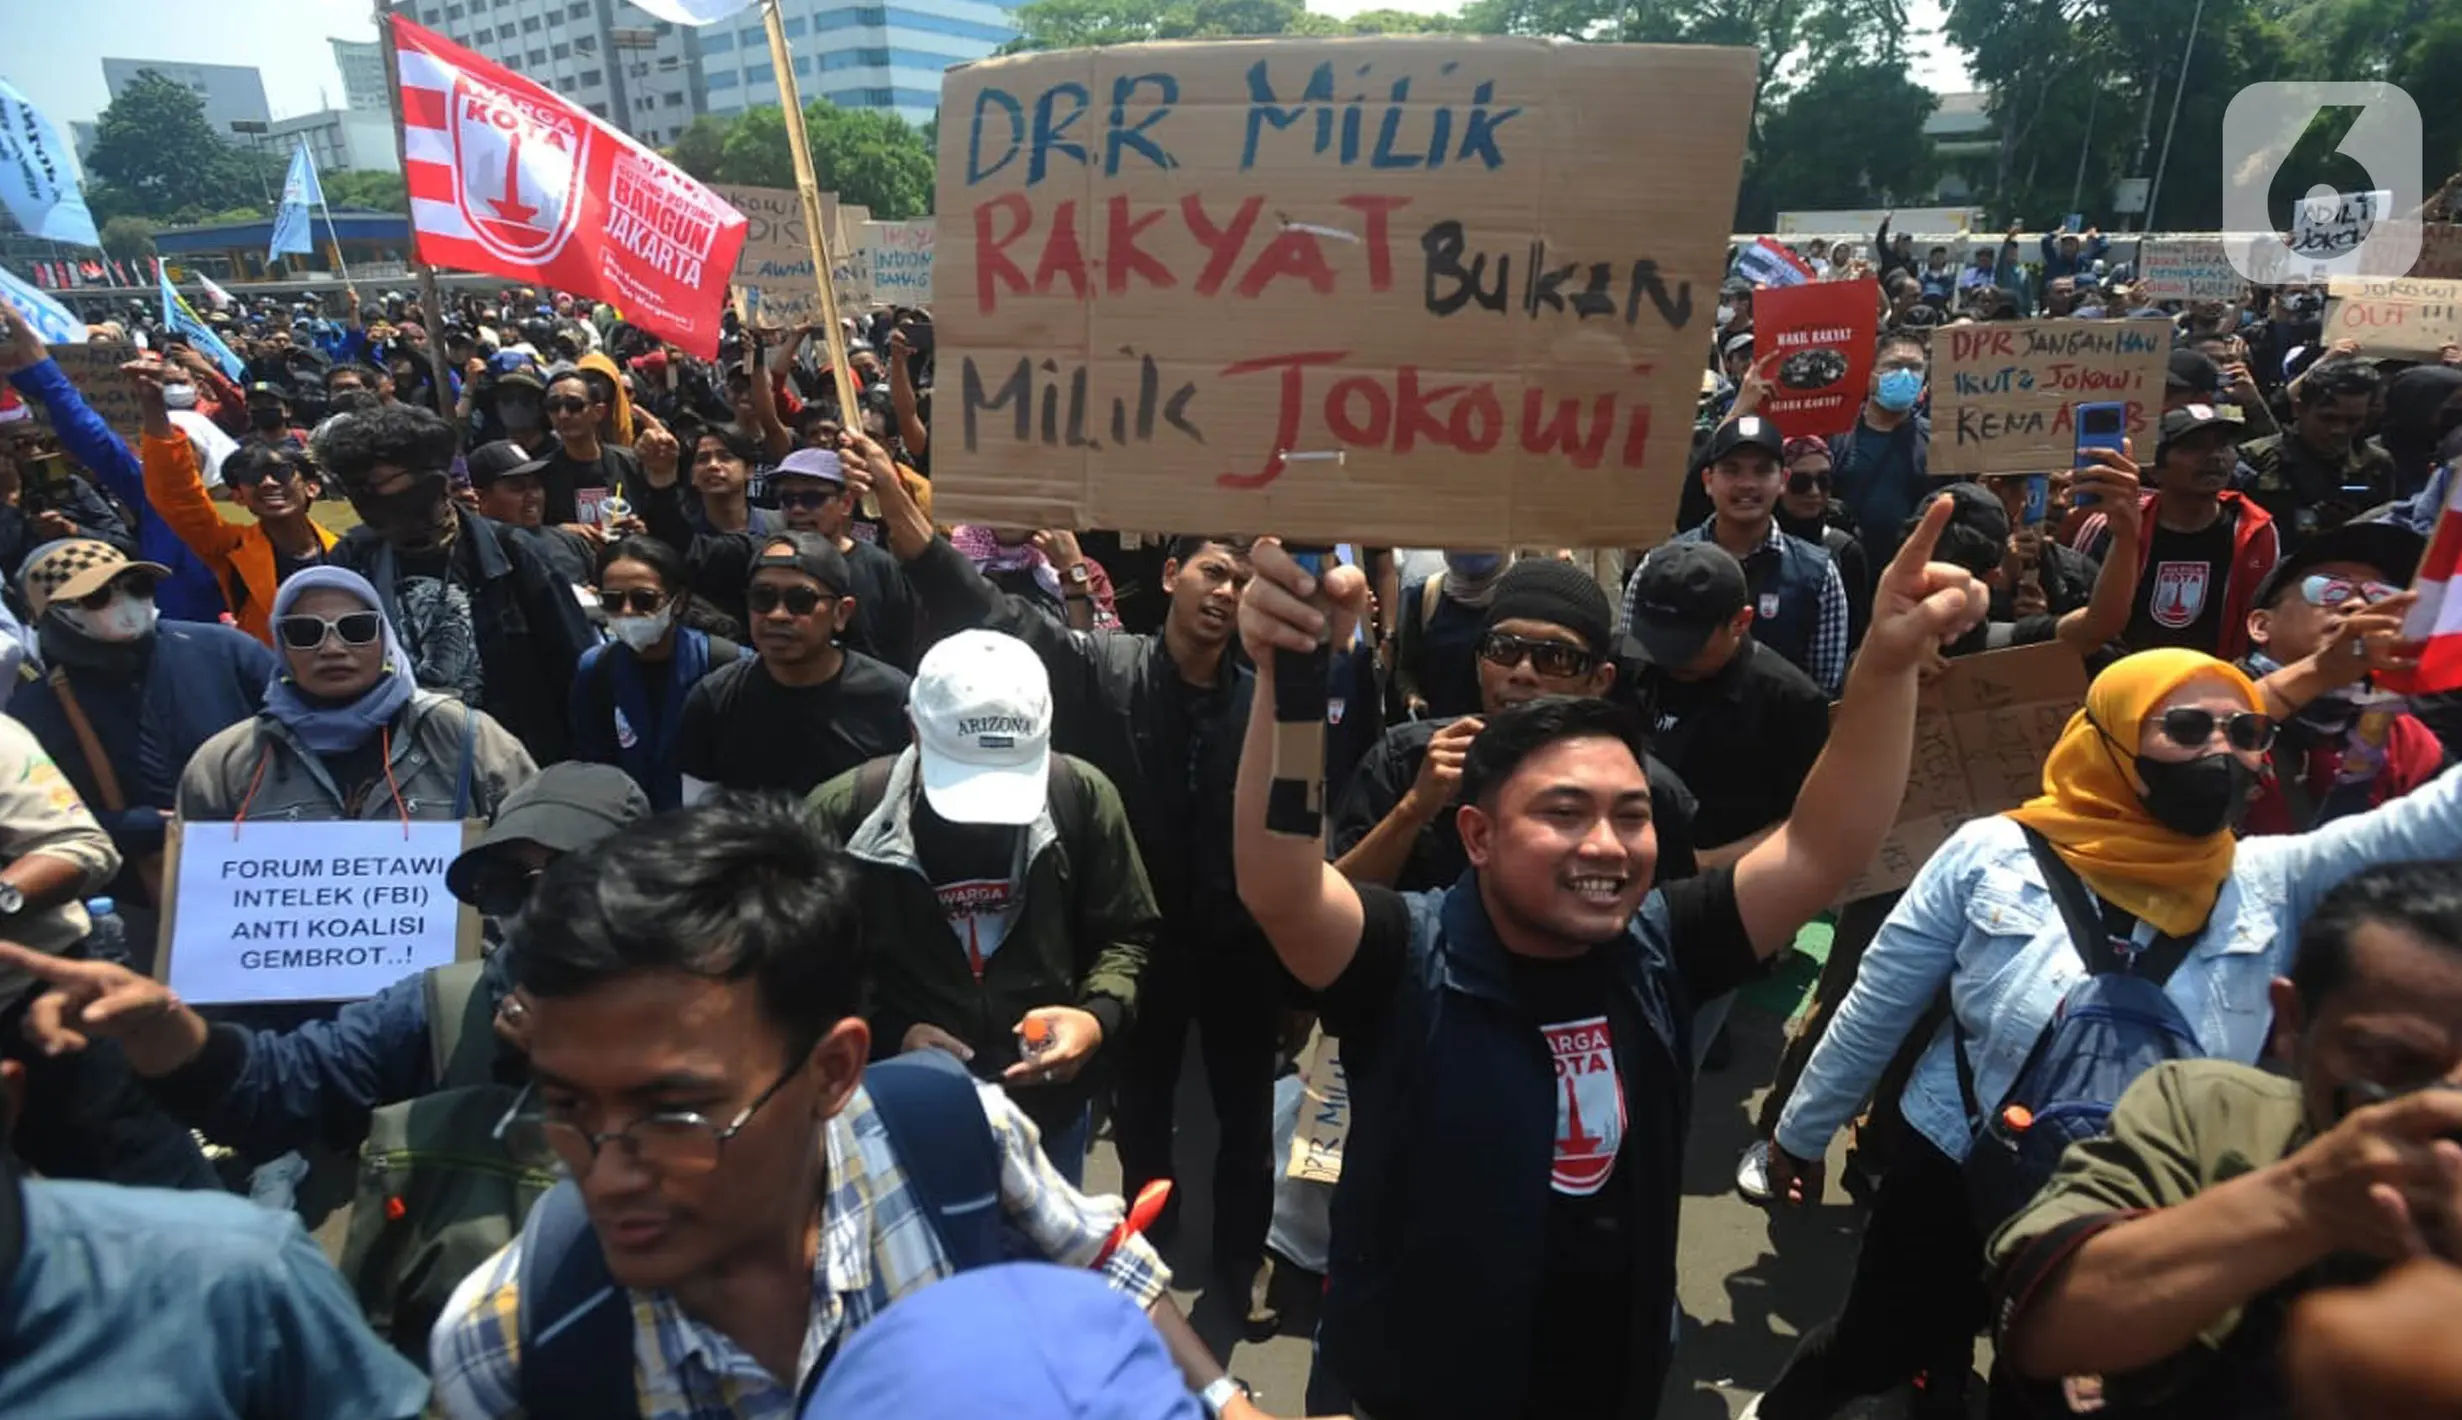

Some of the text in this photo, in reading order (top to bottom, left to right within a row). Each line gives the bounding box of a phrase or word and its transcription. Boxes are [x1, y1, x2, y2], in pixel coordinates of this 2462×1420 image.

[461, 76, 577, 137] WARGA
[466, 98, 567, 153] KOTA
[614, 174, 710, 257] BANGUN
[603, 205, 702, 291] JAKARTA
[974, 193, 1413, 313] RAKYAT
[2344, 304, 2413, 328] OUT
[1812, 328, 1852, 343] RAKYAT
[1952, 329, 2014, 362] DPR
[1957, 406, 2044, 445] KENA
[221, 856, 444, 879] FORUM BETAWI
[233, 886, 429, 909] INTELEK (FBI)
[938, 888, 1003, 904] WARGA
[231, 916, 425, 940] ANTI KOALISI
[240, 945, 413, 970] GEMBROT..!
